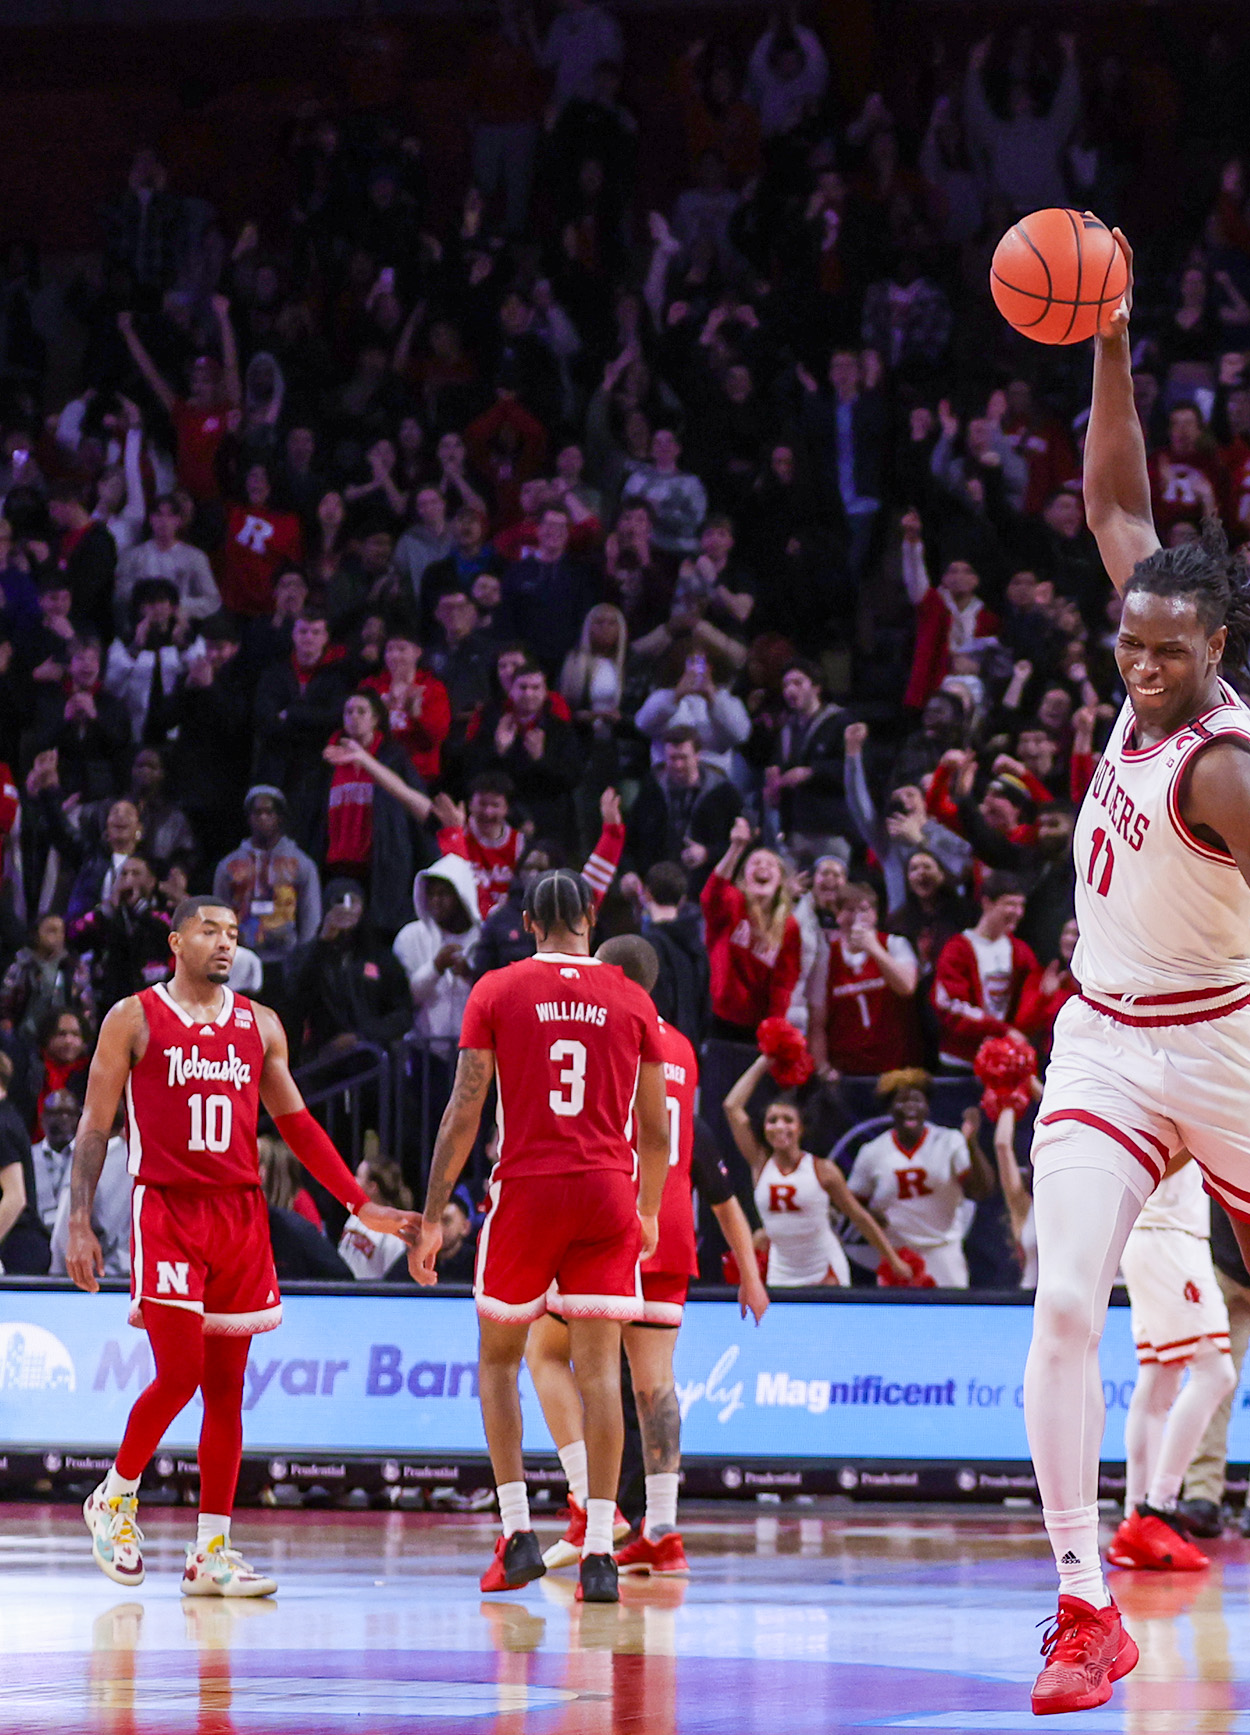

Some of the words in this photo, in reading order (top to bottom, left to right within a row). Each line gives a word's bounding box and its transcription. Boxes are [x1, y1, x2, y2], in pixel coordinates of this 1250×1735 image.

[237, 514, 274, 553] R
[1087, 826, 1115, 897] 11
[535, 1001, 608, 1027] WILLIAMS
[164, 1044, 251, 1091] Nebraska
[549, 1039, 587, 1117] 3
[188, 1093, 232, 1153] 10
[768, 1184, 800, 1212] R
[896, 1168, 933, 1199] R
[156, 1261, 190, 1295] N
[93, 1339, 348, 1411] Myar
[365, 1344, 524, 1399] Ban
[755, 1372, 956, 1414] Magnificent
[967, 1377, 1006, 1408] for
